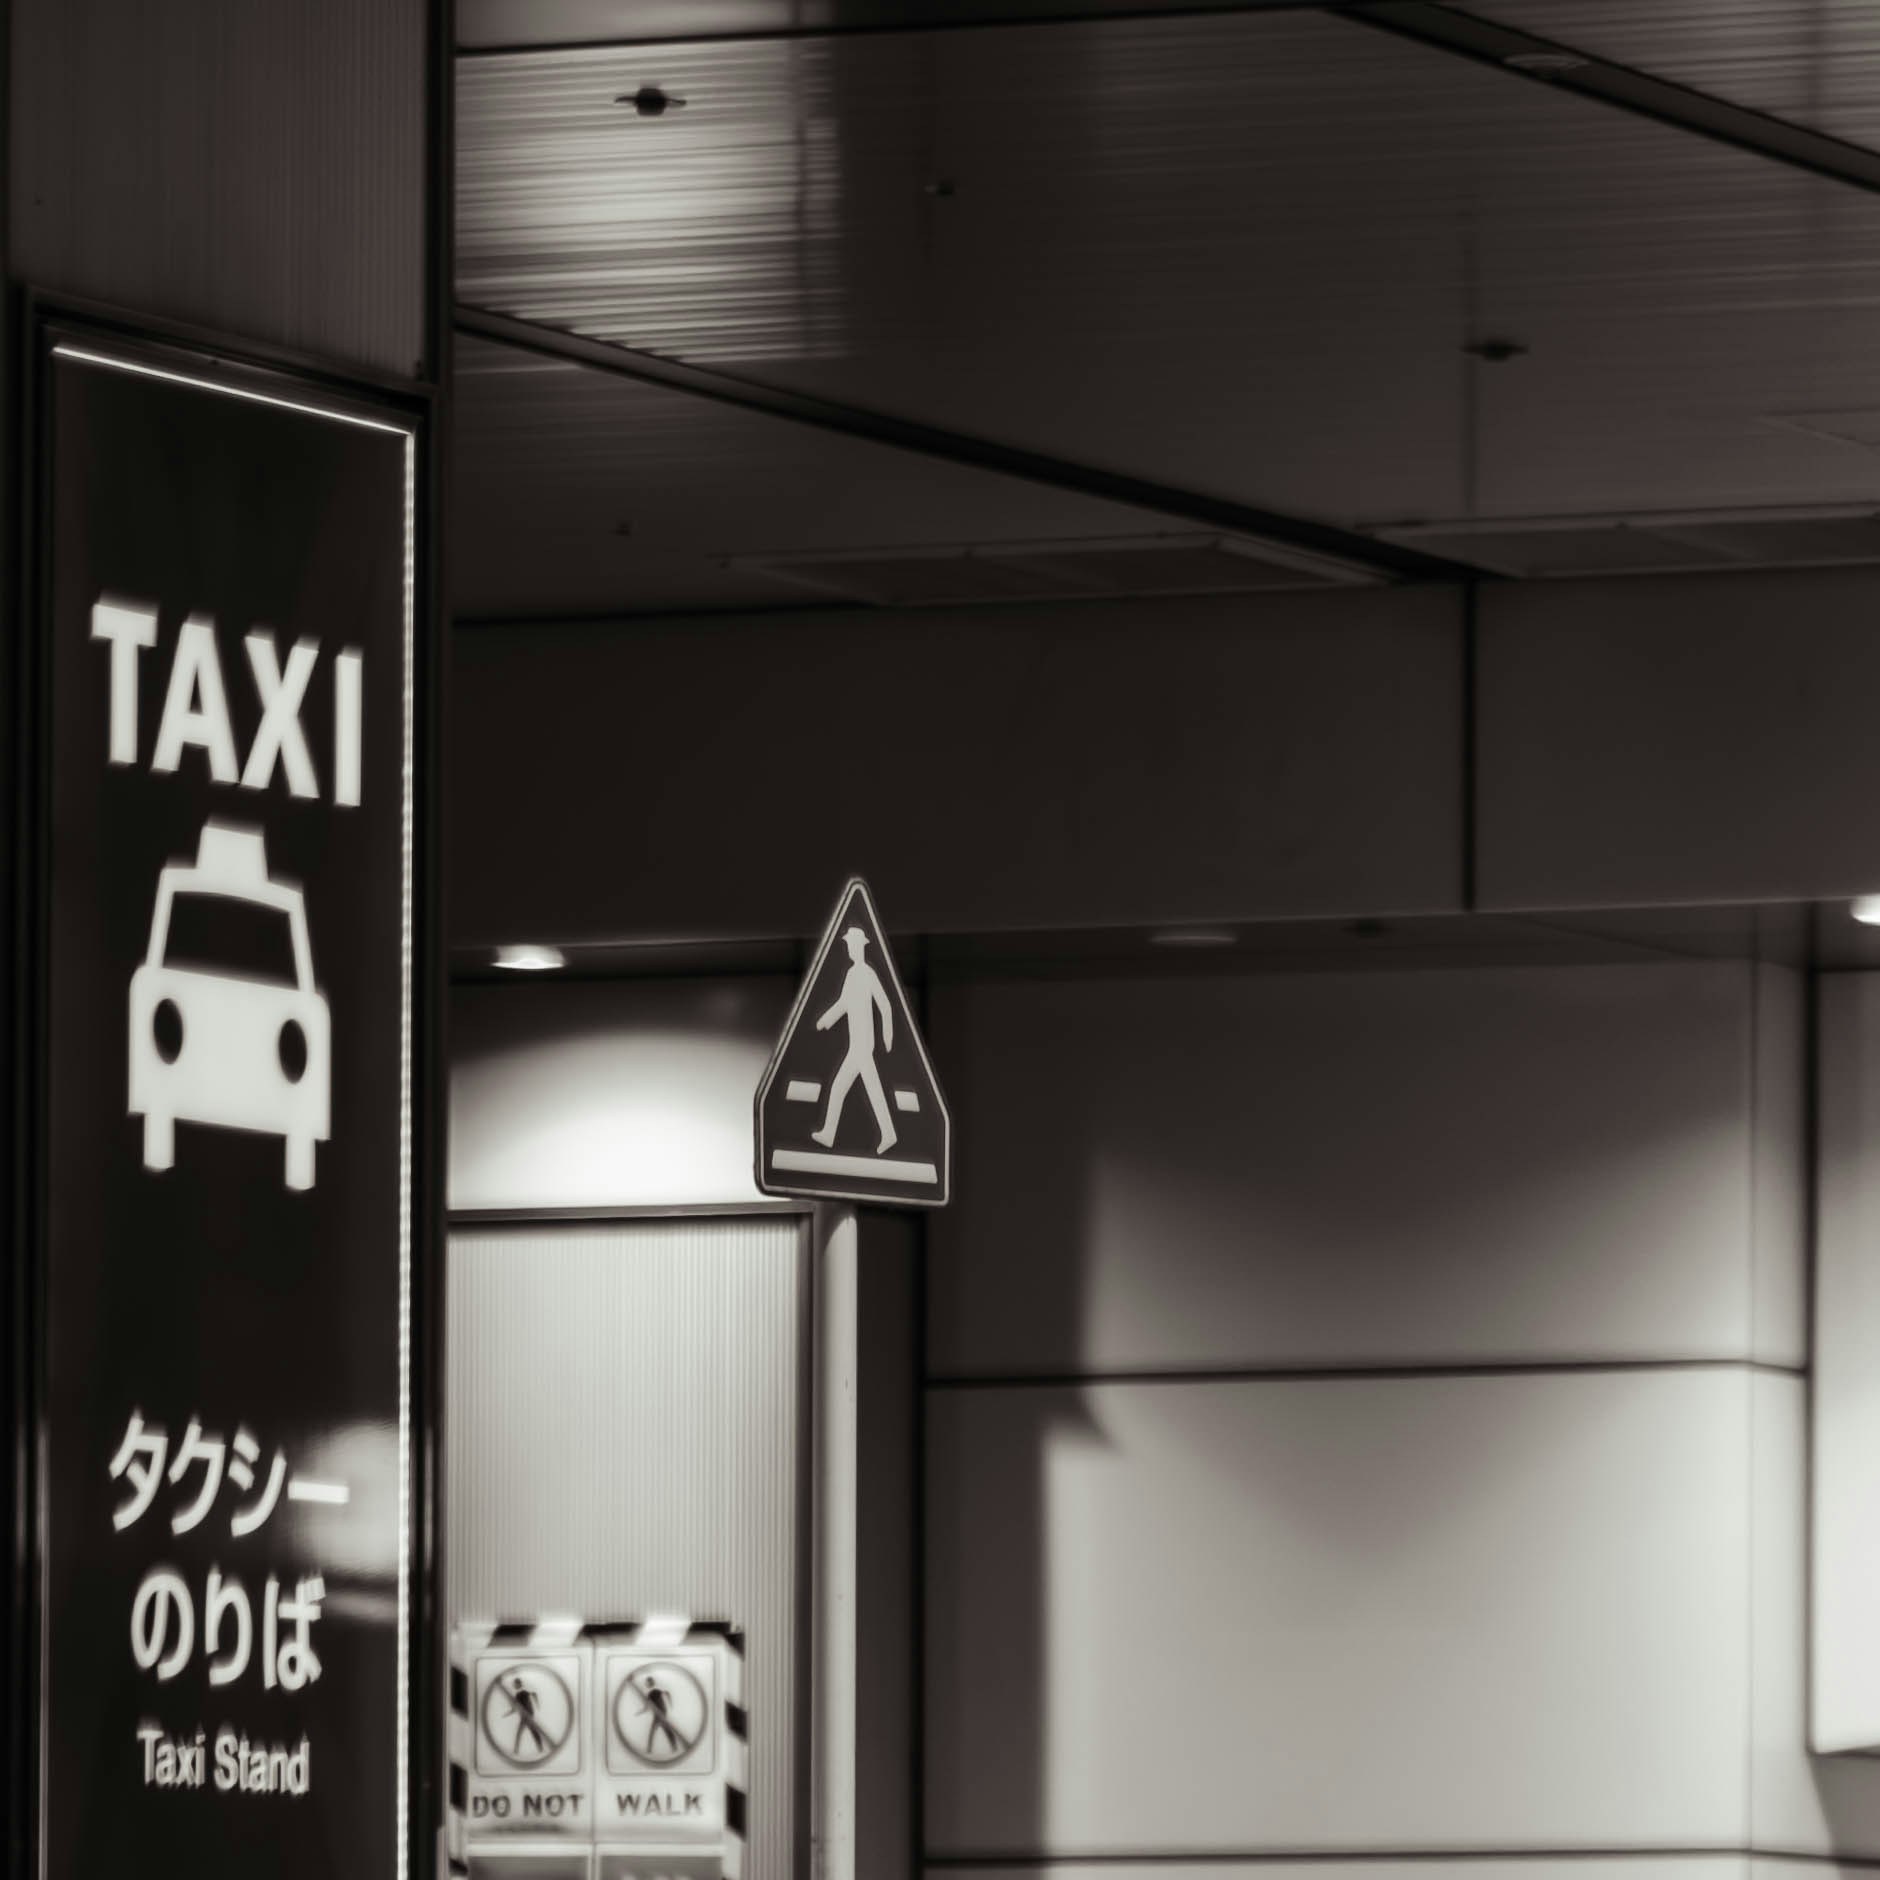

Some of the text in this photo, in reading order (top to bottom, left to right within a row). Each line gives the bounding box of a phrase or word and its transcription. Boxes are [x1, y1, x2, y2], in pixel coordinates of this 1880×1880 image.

[92, 599, 362, 806] TAXI
[109, 1411, 349, 1537] タクシー
[131, 1566, 326, 1690] のりば
[136, 1726, 310, 1795] Taxi Stand
[472, 1793, 702, 1818] DO NOT WALK
